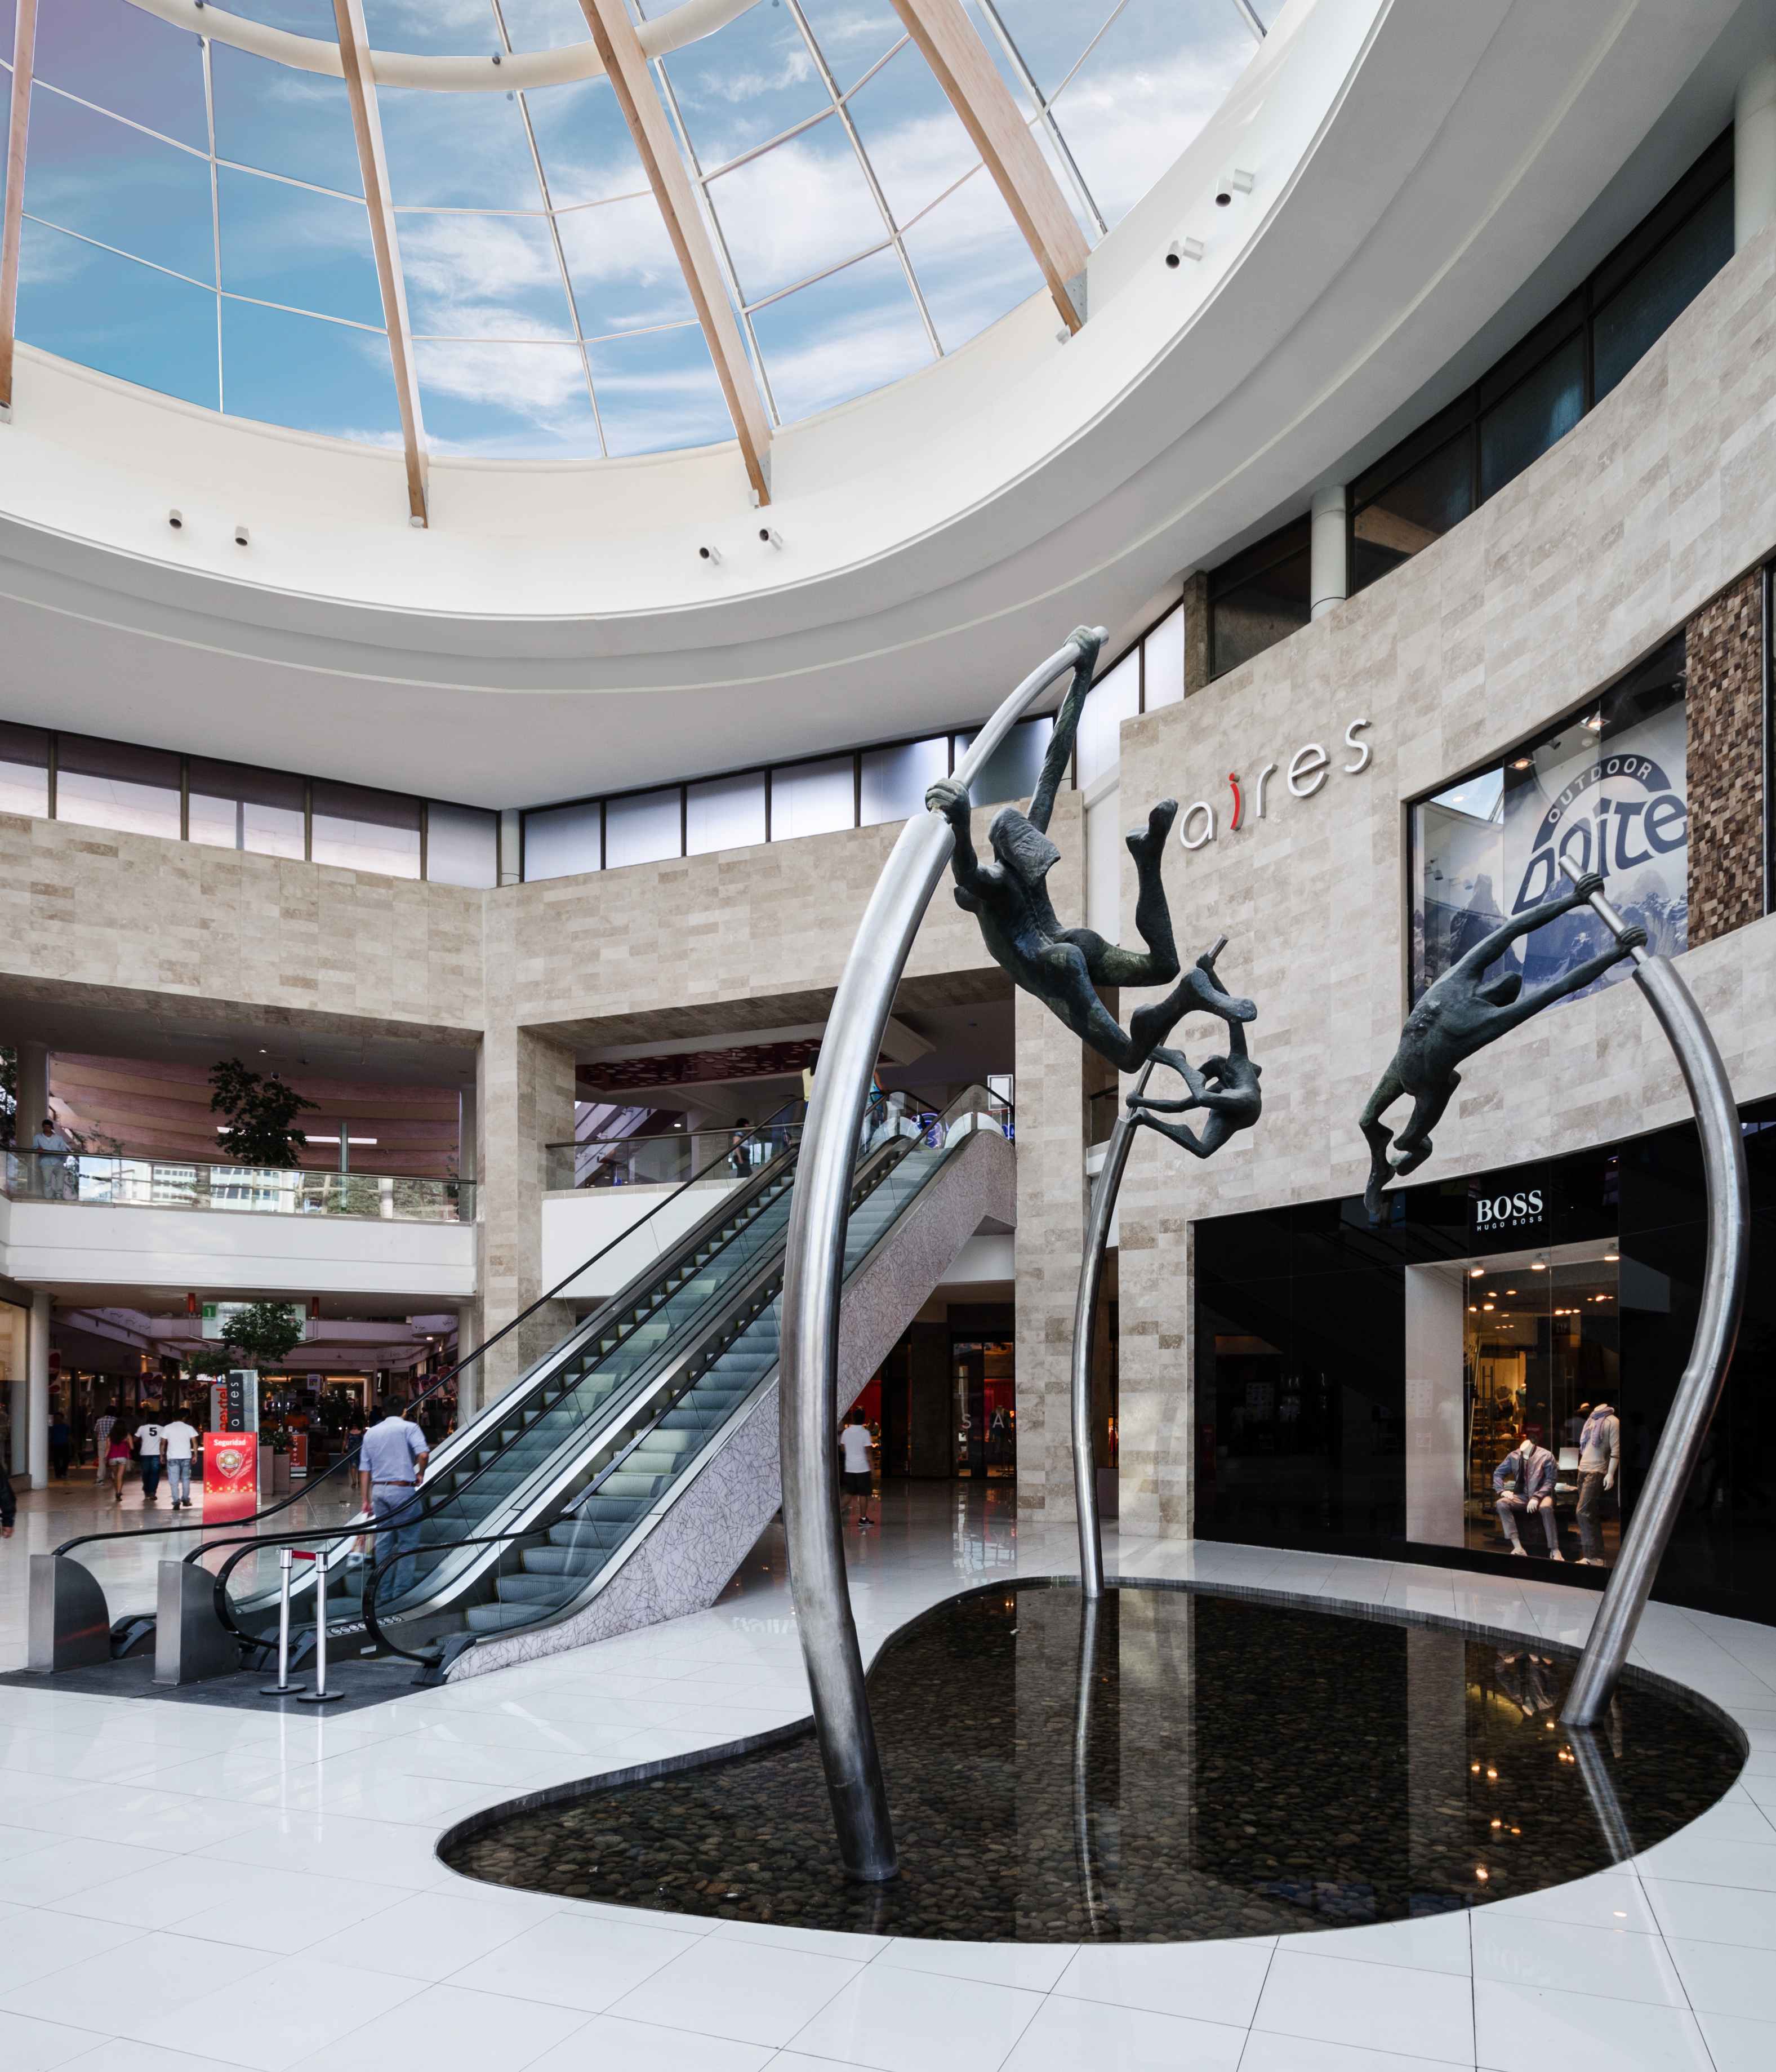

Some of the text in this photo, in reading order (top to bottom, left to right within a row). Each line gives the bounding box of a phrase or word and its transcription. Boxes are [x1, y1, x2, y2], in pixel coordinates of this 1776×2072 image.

[1179, 719, 1373, 850] aires
[1548, 757, 1652, 824] OUTDOOR
[1476, 1190, 1543, 1223] BOSS
[1477, 1215, 1542, 1231] HUGO BOSS
[230, 1382, 240, 1426] aires
[149, 1427, 157, 1437] 5
[213, 1439, 246, 1447] Seguridad
